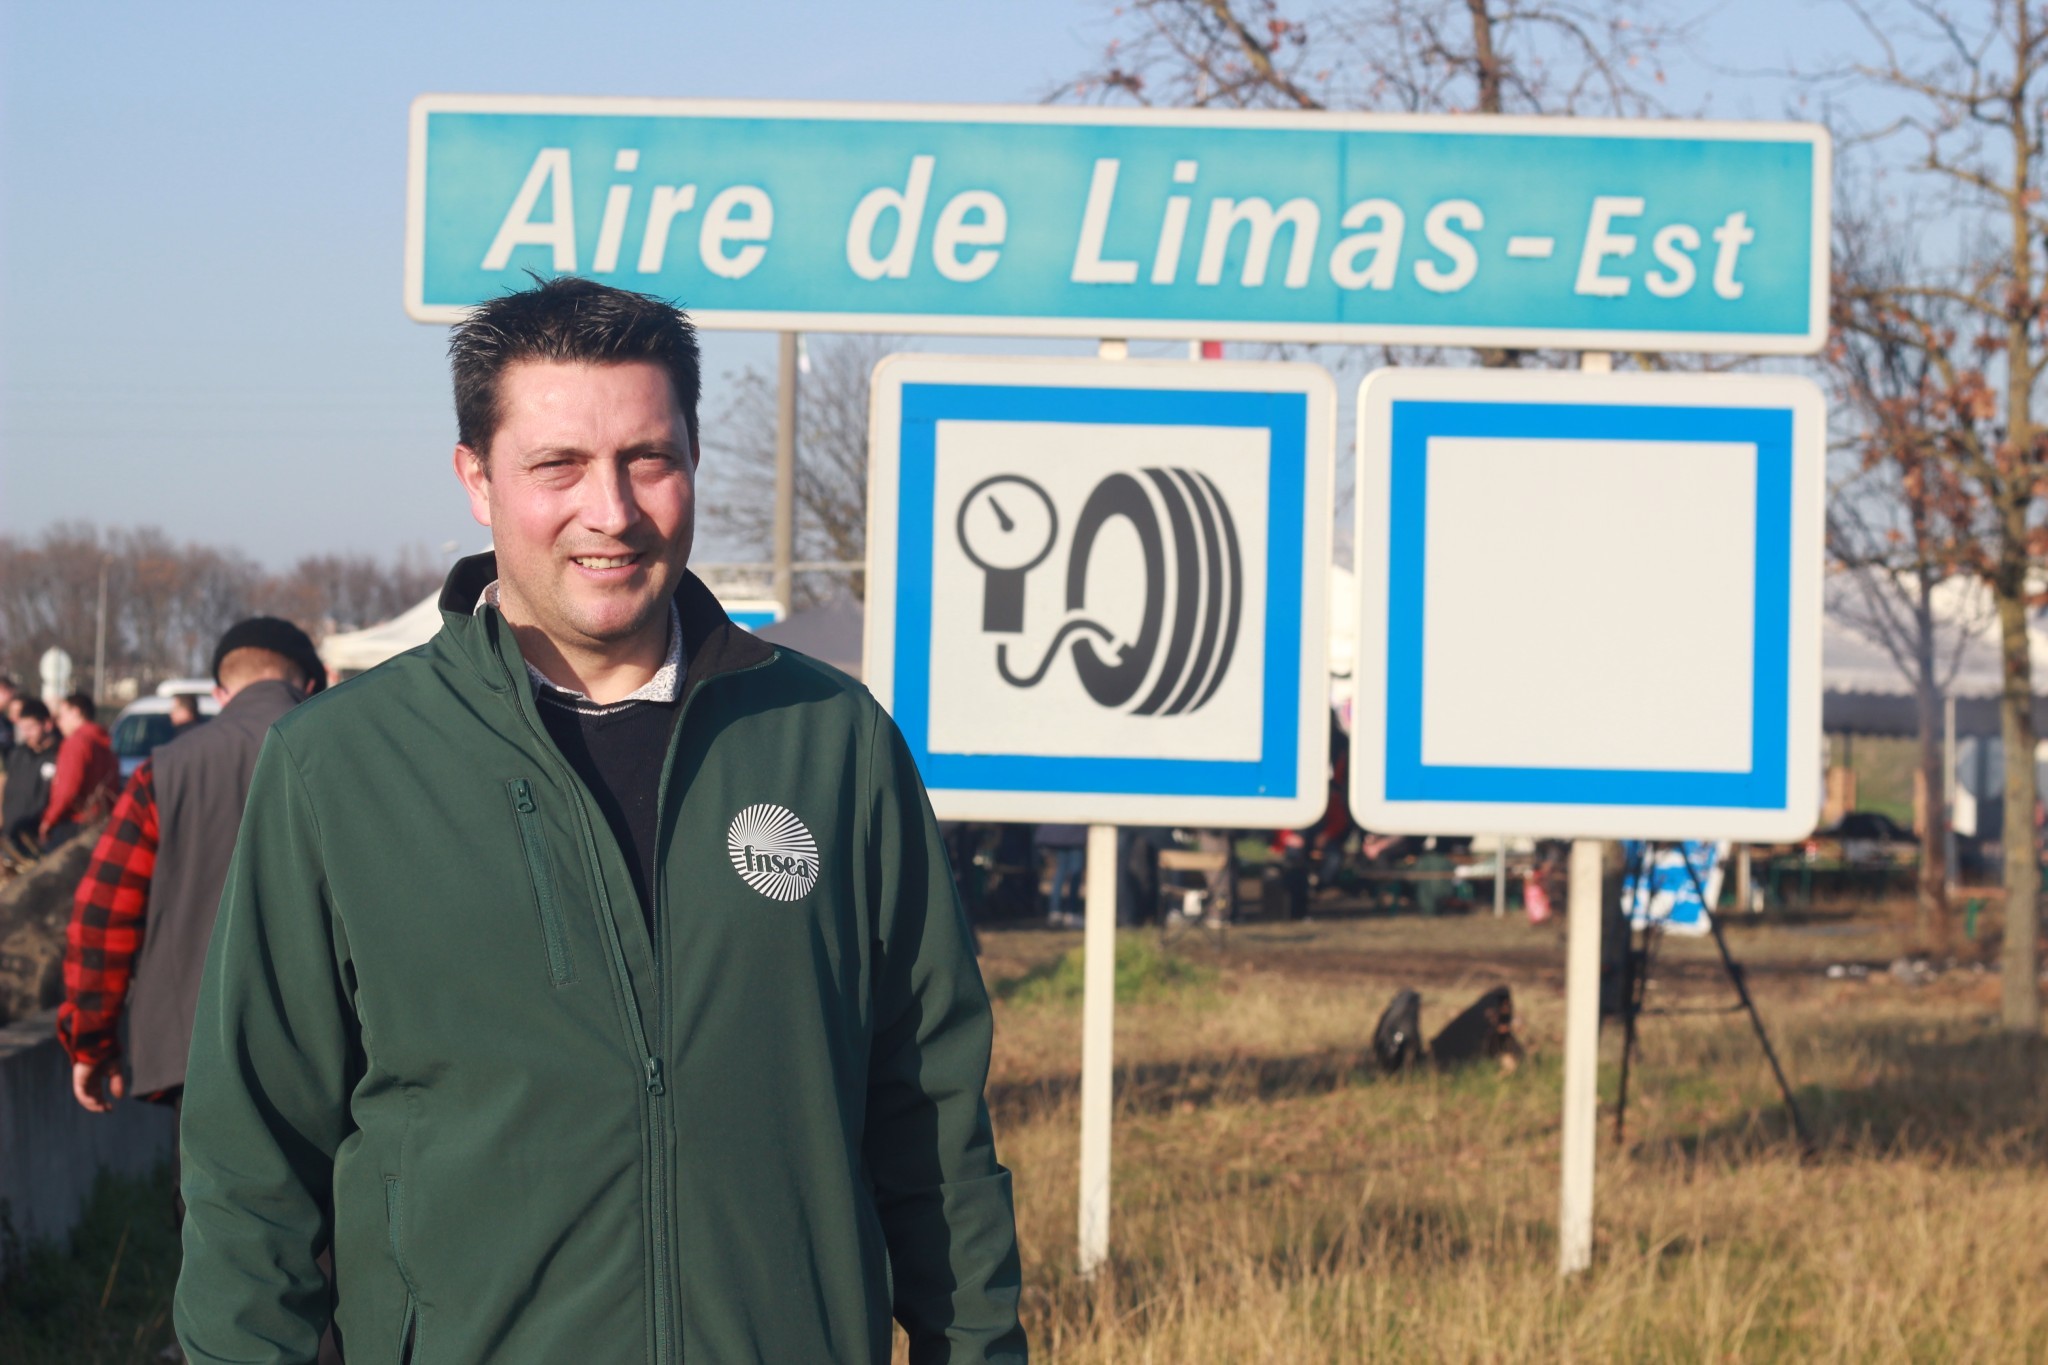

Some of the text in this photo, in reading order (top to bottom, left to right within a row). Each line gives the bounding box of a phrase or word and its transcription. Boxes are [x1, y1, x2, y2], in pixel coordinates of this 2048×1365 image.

[480, 147, 774, 280] Aire
[845, 154, 1008, 283] de
[743, 844, 810, 879] fnsea
